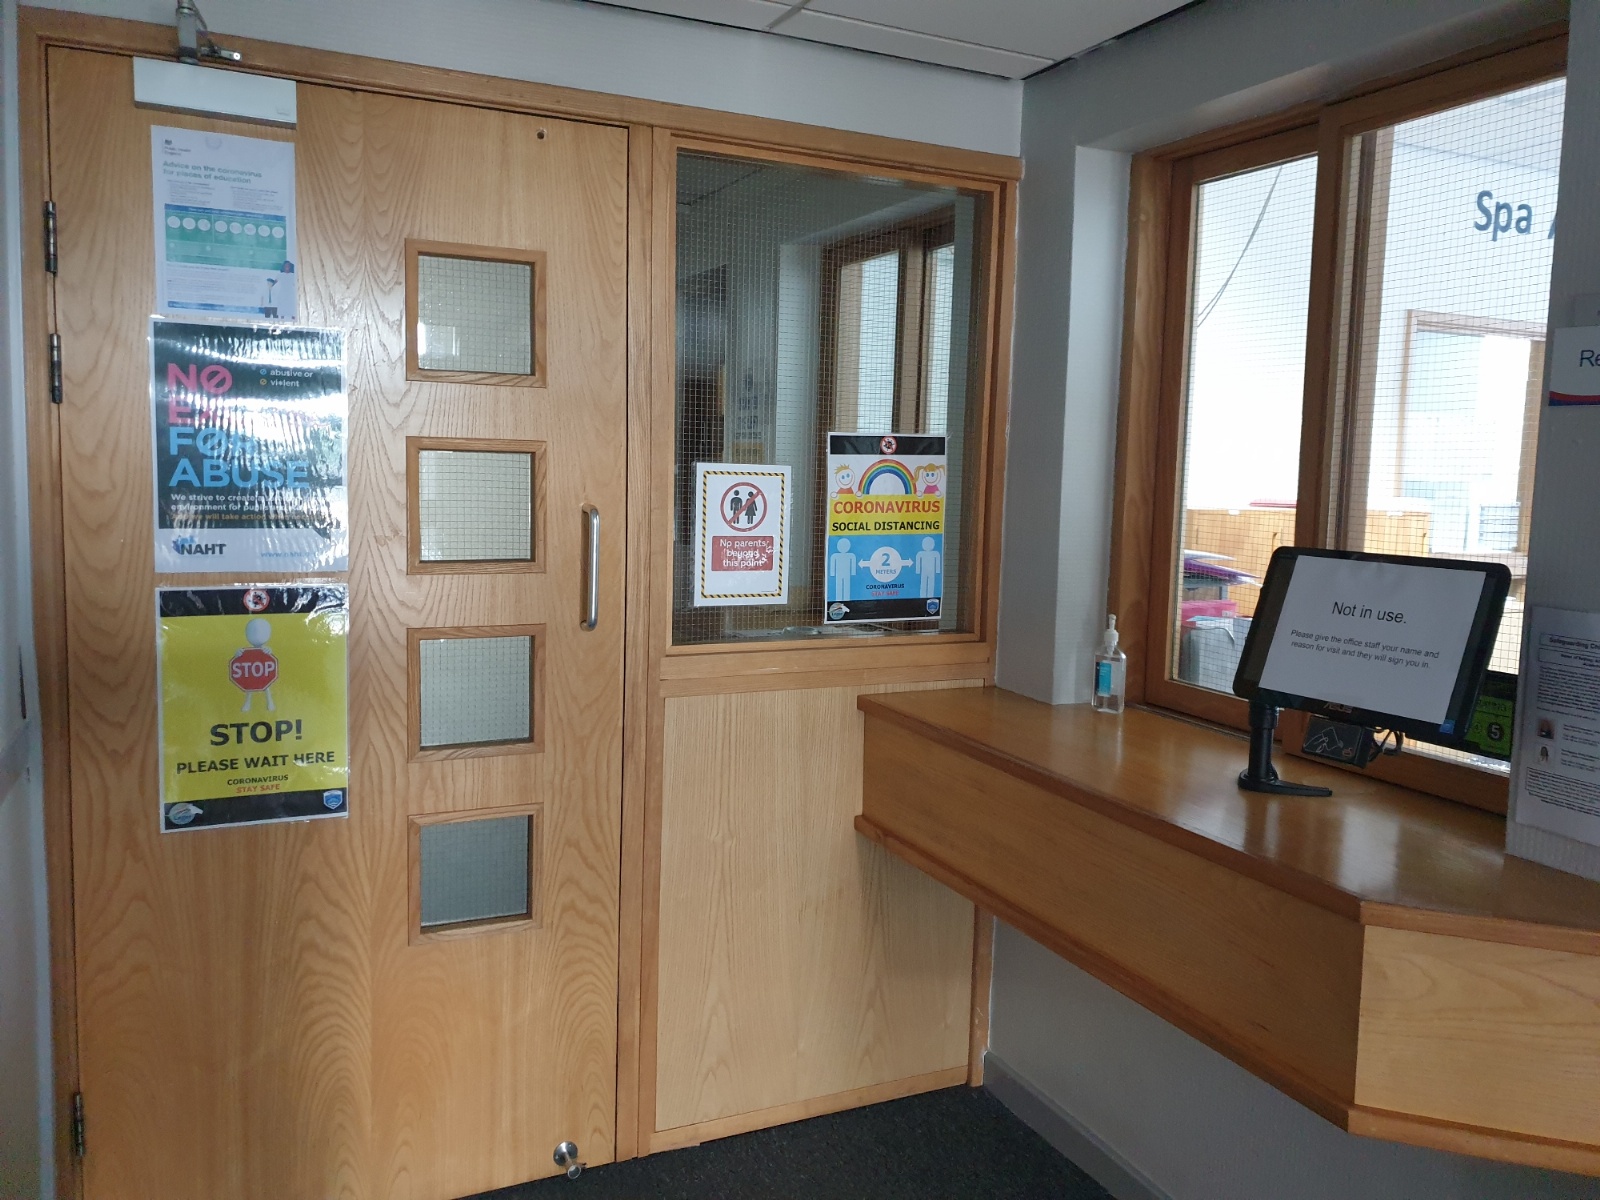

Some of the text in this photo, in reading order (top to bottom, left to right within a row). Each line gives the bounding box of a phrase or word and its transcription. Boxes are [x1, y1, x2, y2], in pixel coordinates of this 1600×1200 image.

[163, 161, 189, 169] Advice
[217, 167, 262, 178] coronavirus
[176, 170, 202, 179] places
[214, 174, 251, 183] education
[1474, 190, 1533, 242] Spa
[270, 368, 303, 377] abusive
[270, 379, 300, 387] violent
[168, 457, 310, 489] ABUSE
[171, 493, 186, 501] We
[188, 493, 212, 501] strive
[171, 502, 227, 511] environment
[228, 502, 241, 511] for
[833, 501, 941, 514] CORONAVIRUS
[832, 520, 940, 532] SOCIAL DISTANCING
[180, 543, 227, 555] NAHT
[734, 540, 766, 548] parents
[723, 559, 763, 568] this point
[881, 552, 891, 567] 2
[1331, 601, 1407, 624] Not in use.
[1290, 629, 1314, 640] Please
[1315, 633, 1329, 642] give
[1330, 635, 1342, 644] the
[1343, 637, 1363, 647] office
[1364, 641, 1381, 650] staff
[1400, 647, 1422, 656] name
[1423, 650, 1440, 659] and
[1549, 636, 1589, 649] Safeguarding
[1290, 641, 1431, 669] reason for visit and they will sign you in.
[231, 661, 275, 678] STOP
[210, 719, 303, 747] STOP!
[1490, 724, 1500, 739] 5
[176, 751, 335, 775] PLEASE WAIT HERE
[227, 774, 289, 786] CORONAVIRUS
[235, 784, 281, 794] STAY SAFE
